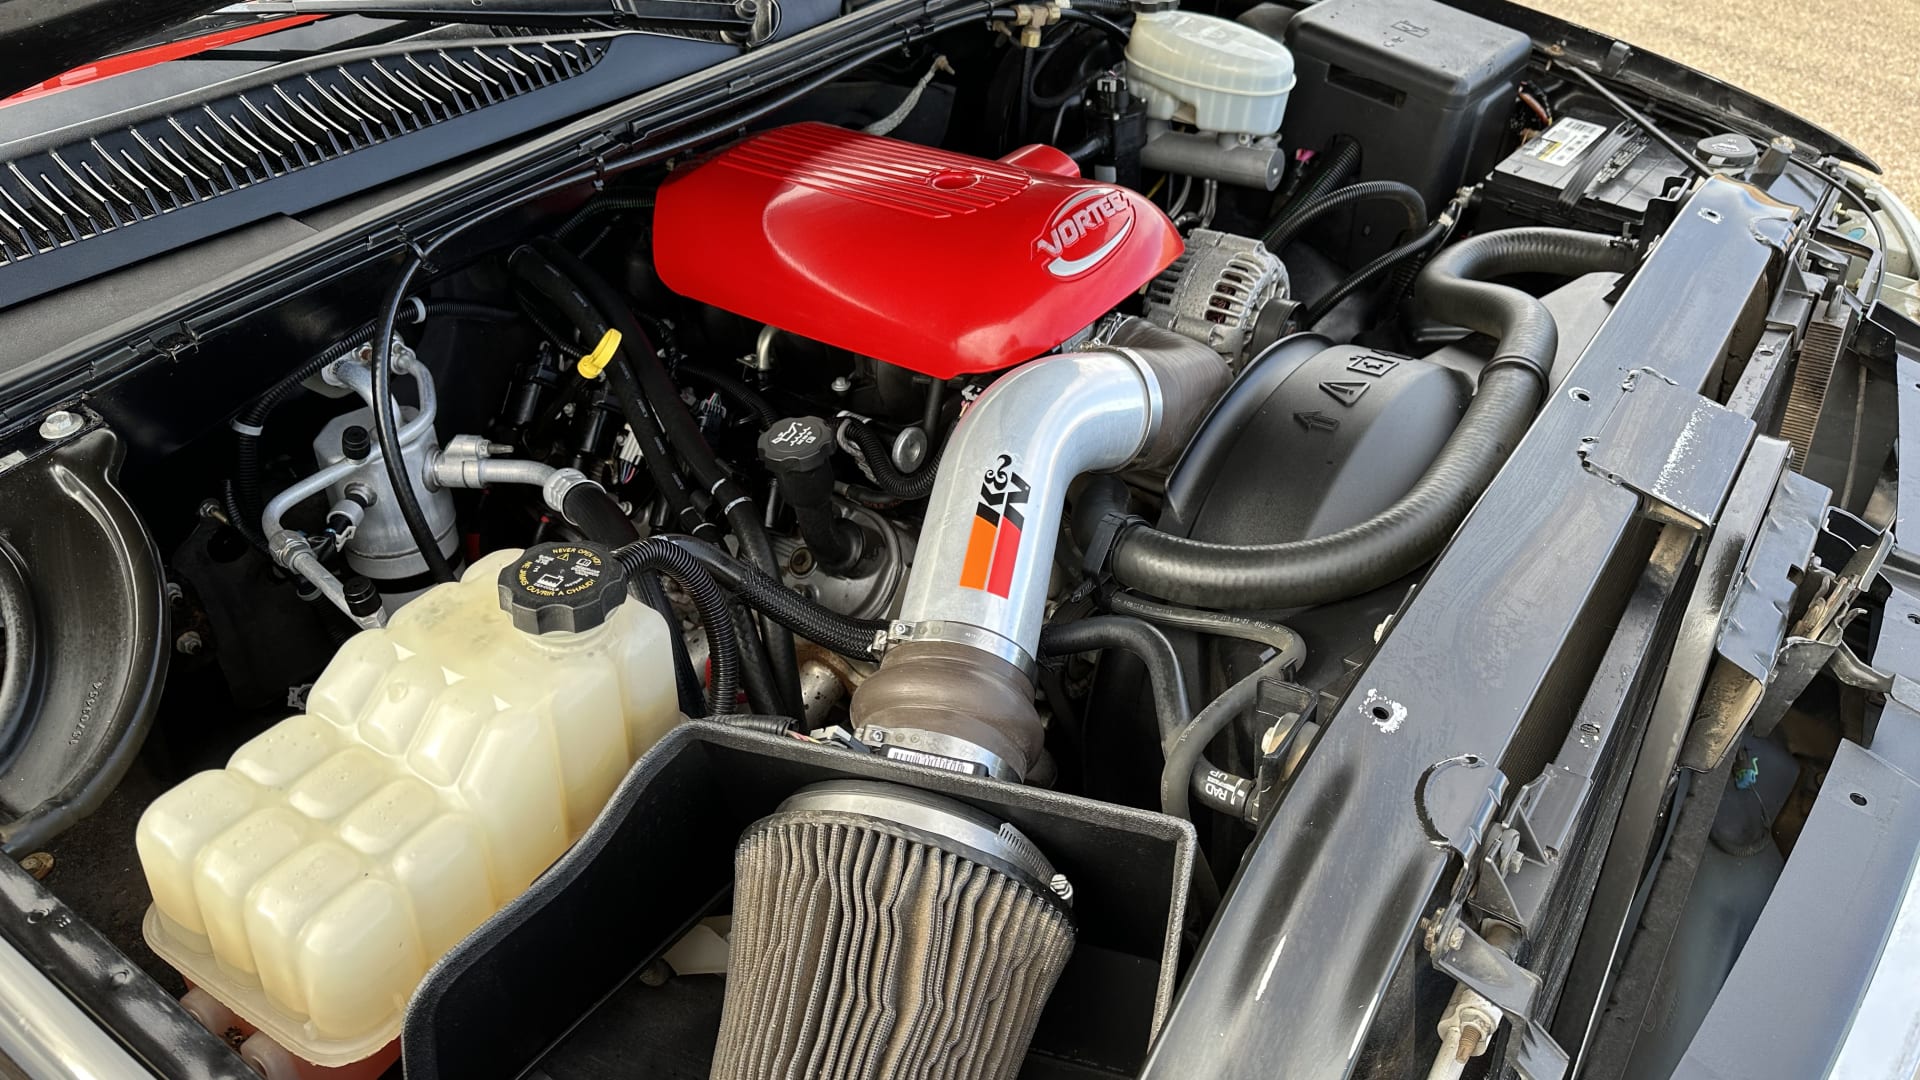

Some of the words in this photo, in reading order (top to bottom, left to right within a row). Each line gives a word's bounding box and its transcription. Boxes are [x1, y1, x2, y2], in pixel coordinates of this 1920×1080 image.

[976, 454, 1031, 532] K&N
[577, 548, 594, 558] OPEN
[1209, 769, 1229, 781] UP
[1205, 782, 1228, 801] RAD
